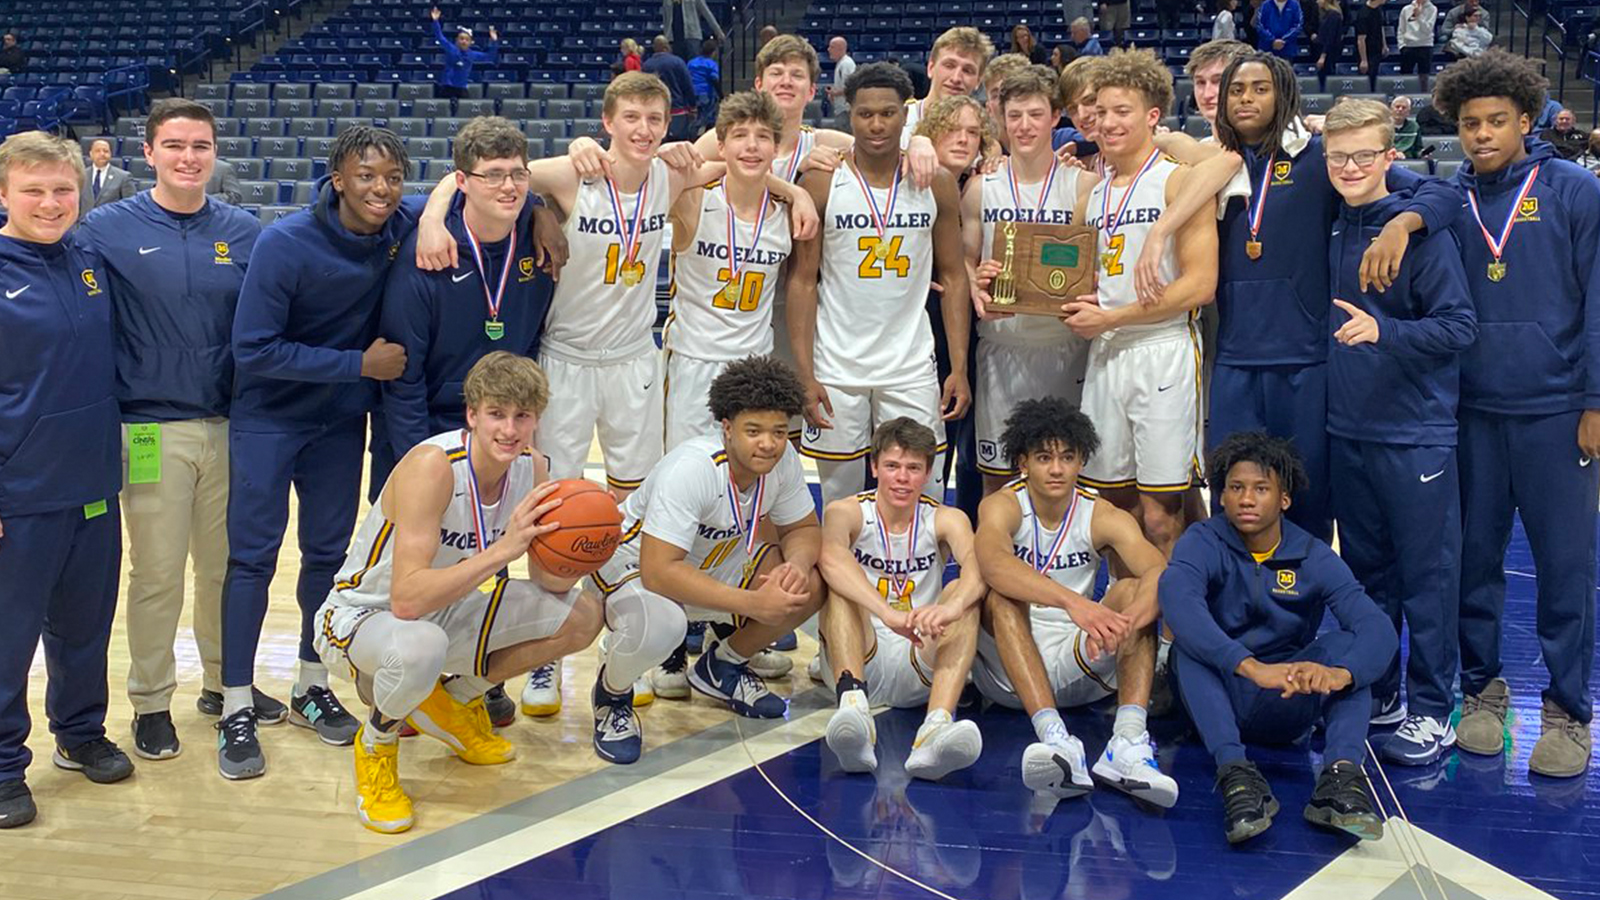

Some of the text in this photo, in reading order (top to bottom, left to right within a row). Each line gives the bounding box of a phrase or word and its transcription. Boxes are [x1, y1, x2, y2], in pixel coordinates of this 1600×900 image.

[1088, 207, 1161, 230] OELER
[858, 235, 910, 278] 24
[712, 267, 766, 312] 20
